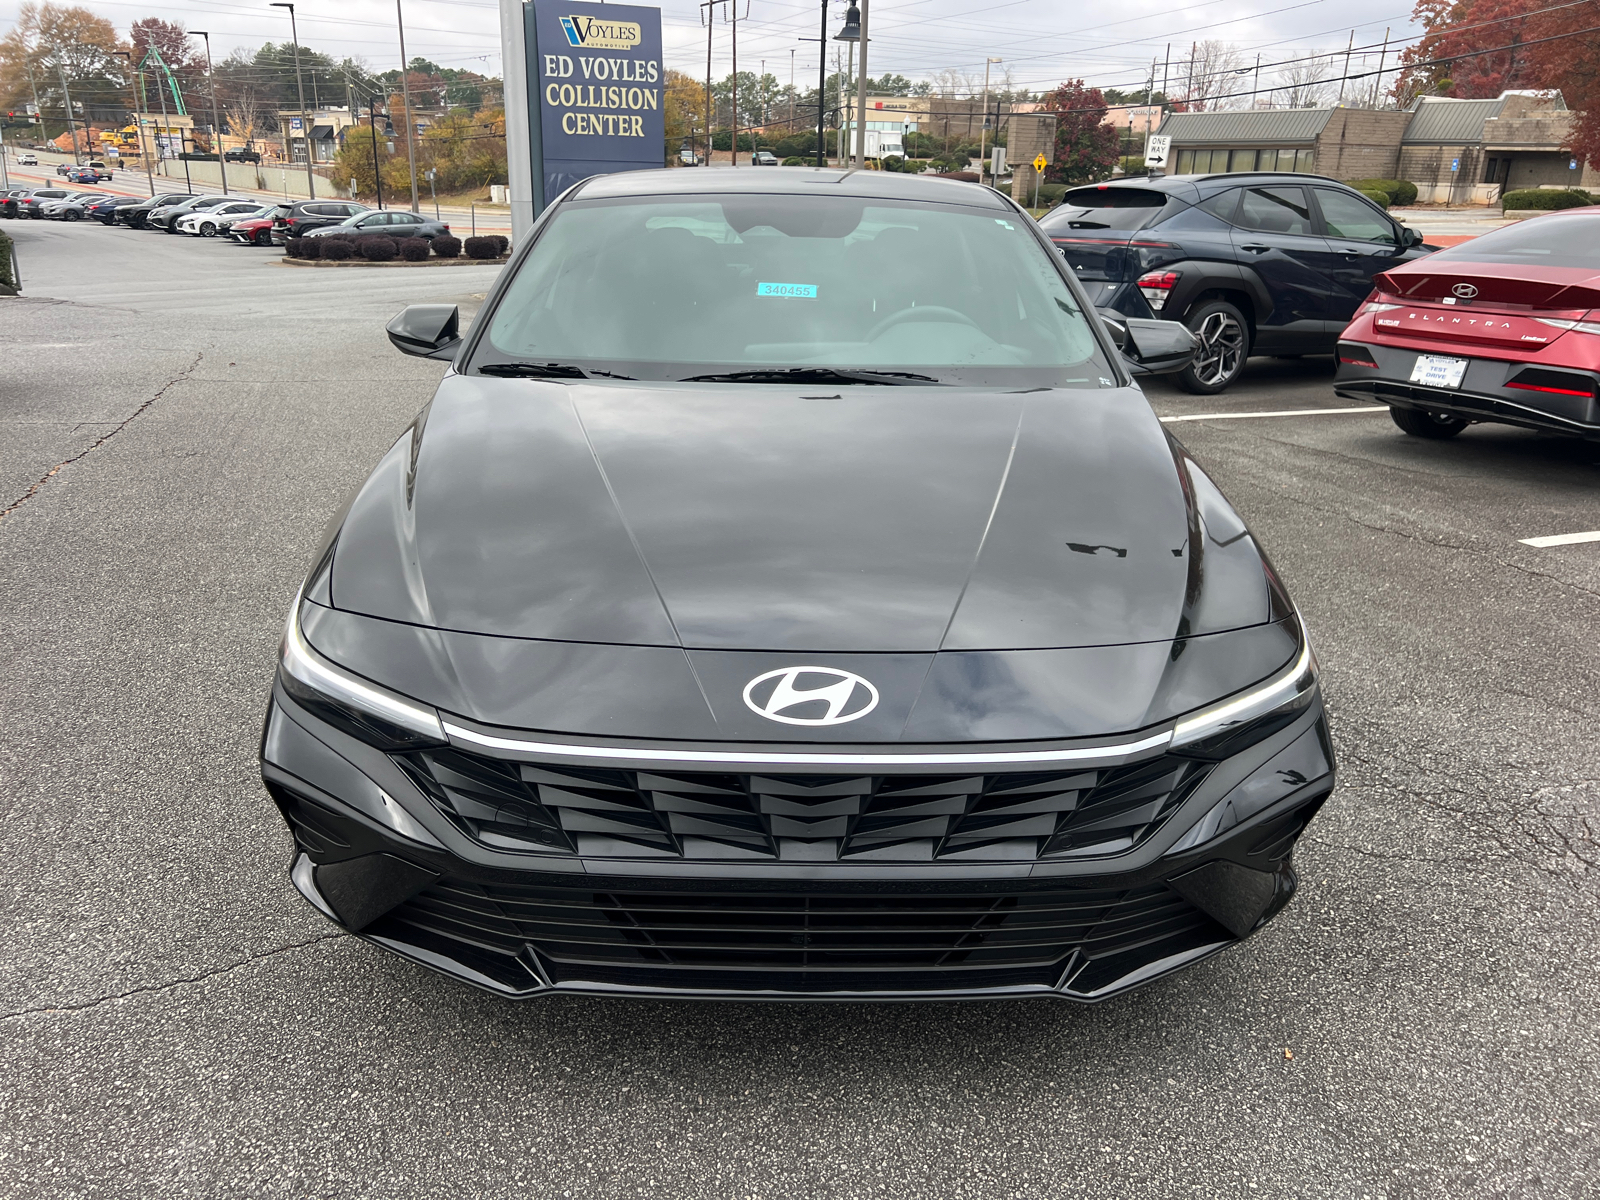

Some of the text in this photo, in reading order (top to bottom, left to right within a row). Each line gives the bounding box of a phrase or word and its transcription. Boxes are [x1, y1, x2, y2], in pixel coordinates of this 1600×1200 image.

[571, 16, 636, 42] VOYLES
[543, 54, 658, 83] ED VOYLES
[545, 83, 658, 111] COLLISION
[562, 112, 645, 137] CENTER
[1151, 137, 1167, 146] ONE
[1150, 146, 1166, 154] WAY
[765, 285, 810, 296] 340455
[1409, 313, 1510, 328] ELANTRA
[1425, 372, 1447, 380] DRIVE
